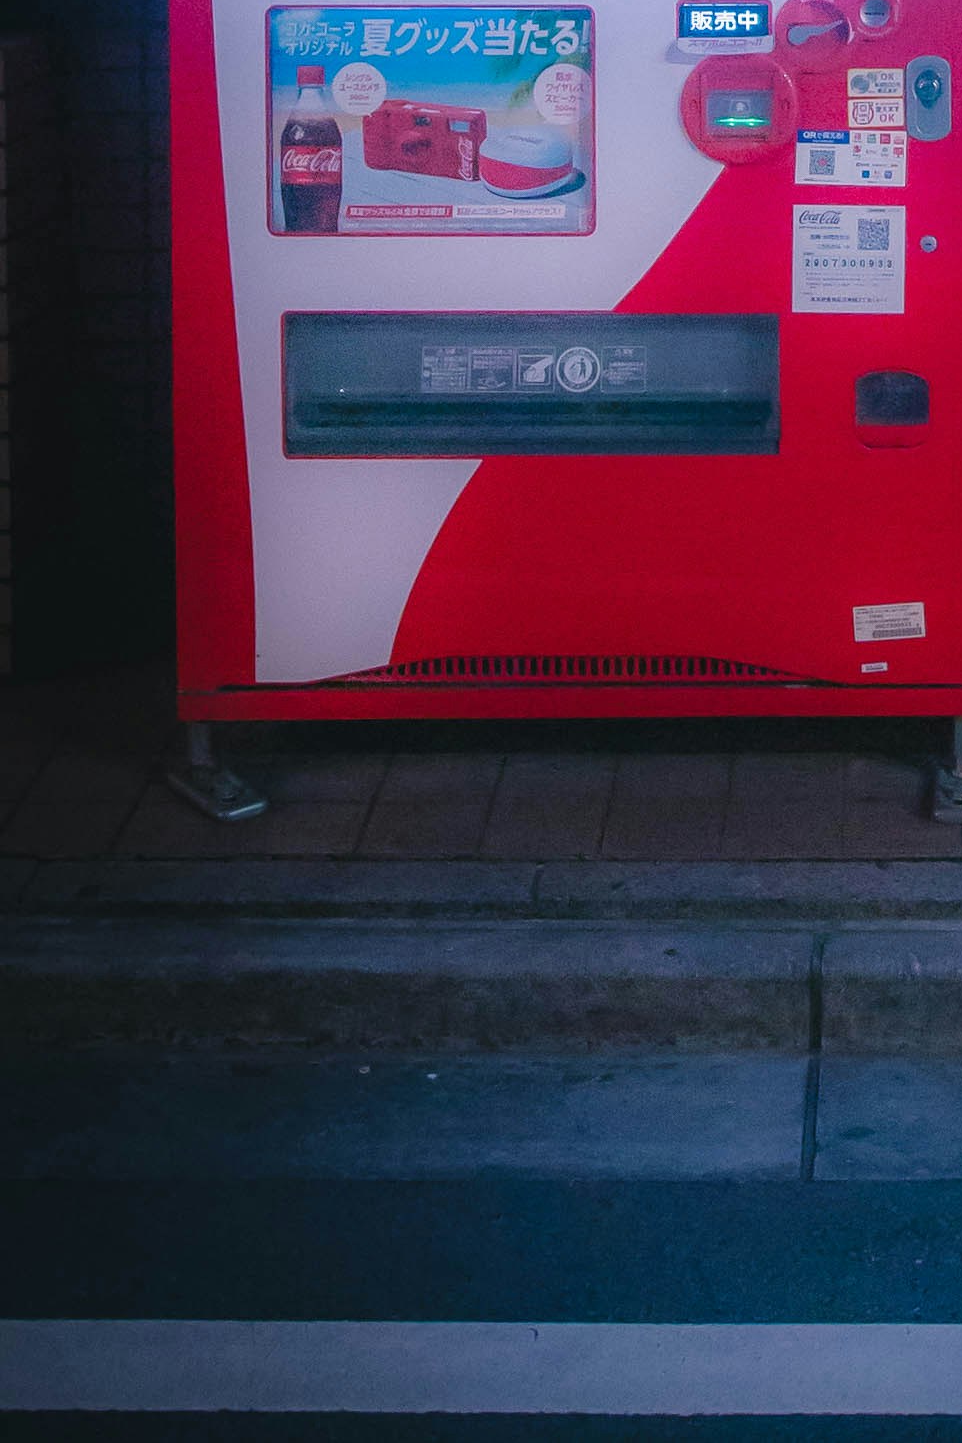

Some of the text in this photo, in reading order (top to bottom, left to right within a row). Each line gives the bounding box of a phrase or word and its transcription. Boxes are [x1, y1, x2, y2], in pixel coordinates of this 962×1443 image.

[286, 21, 355, 35] コカ・コーラ
[690, 10, 758, 31] 販売中
[360, 17, 590, 57] 夏グッズ当たる!
[285, 40, 352, 56] オリジナル
[880, 114, 895, 123] OK
